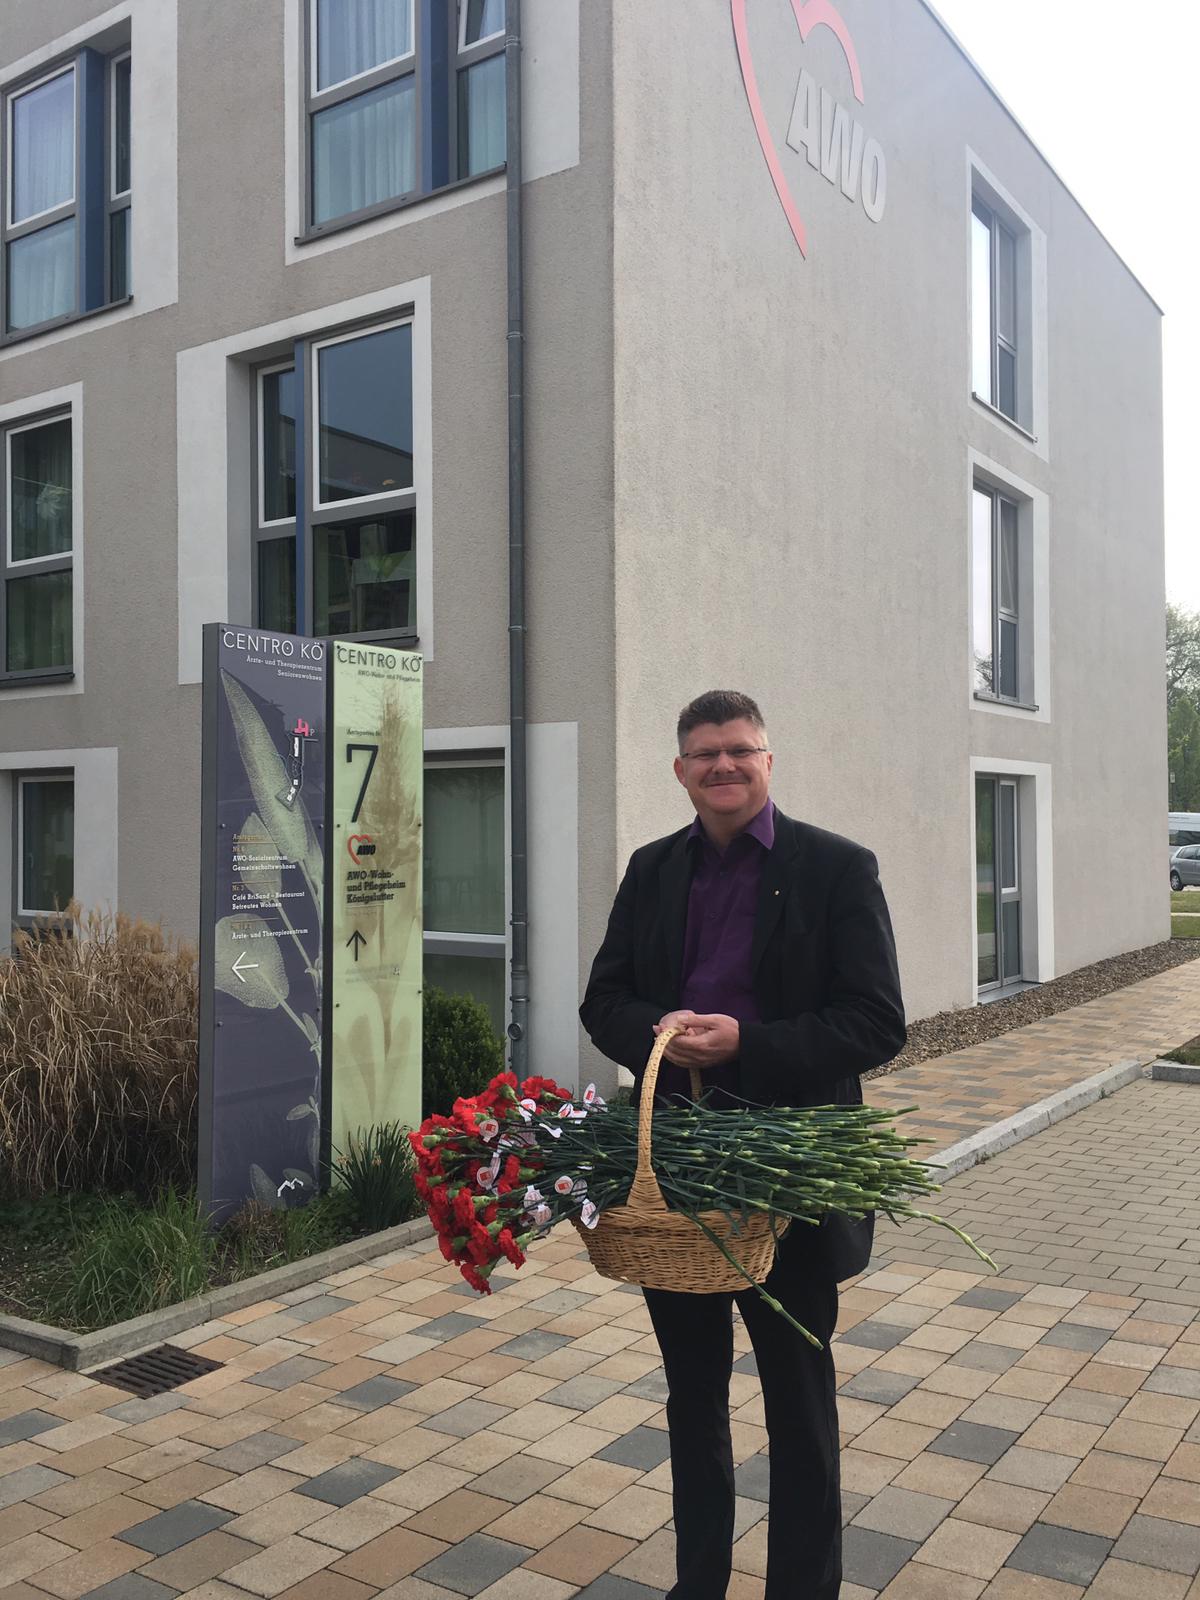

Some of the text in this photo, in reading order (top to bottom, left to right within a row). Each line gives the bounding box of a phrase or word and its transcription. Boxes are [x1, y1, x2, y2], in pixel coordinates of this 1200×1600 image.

[785, 67, 887, 223] AWO
[223, 631, 323, 661] CENTRO KÖ
[337, 648, 420, 672] CENTRO KÖ
[346, 744, 379, 823] 7
[357, 845, 376, 855] AWO
[347, 881, 406, 892] und Pflegeheim
[347, 893, 394, 904] Königslutter
